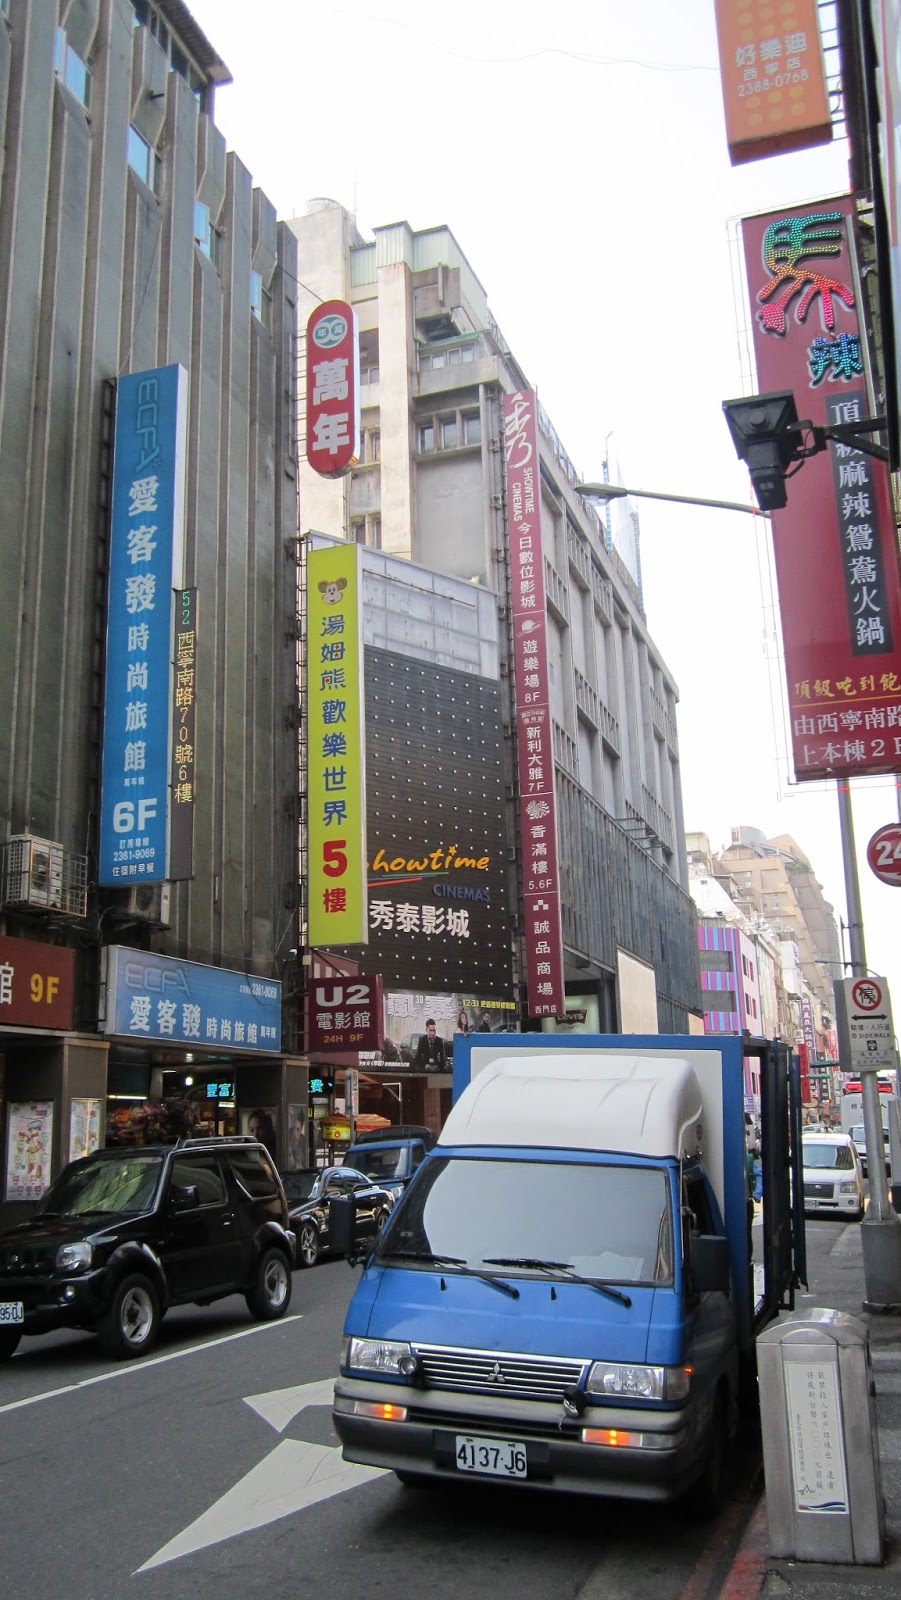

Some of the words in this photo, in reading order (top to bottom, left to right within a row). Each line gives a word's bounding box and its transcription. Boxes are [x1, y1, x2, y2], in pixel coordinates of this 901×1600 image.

[735, 32, 807, 68] 好樂迪
[738, 69, 809, 97] 2388-0768
[313, 358, 349, 455] 萬年
[512, 482, 523, 521] CINEMAS
[523, 467, 535, 513] SHOWTIME
[517, 522, 537, 608] 今日數位影城
[523, 640, 540, 688] 遊樂場
[525, 692, 540, 703] 8F
[794, 672, 901, 699] 頂級吃到飽
[320, 614, 347, 827] 湯姆熊歡樂世界
[526, 726, 544, 780] 新利大雅
[528, 782, 544, 792] 7F
[113, 798, 157, 833] 6F
[113, 848, 155, 861] 2361-9069
[366, 846, 490, 873] howtime
[530, 825, 548, 875] 香滿樓
[112, 862, 154, 877] 住宿附早餐
[432, 883, 491, 902] CINEMAS
[528, 879, 552, 890] 5.6F
[369, 899, 471, 938] 秀泰影城
[534, 921, 553, 996] 誠品商場
[30, 973, 59, 1004] 9F
[316, 984, 370, 1007] U2
[316, 1011, 370, 1031] 電影館
[535, 1004, 557, 1014] 西門店
[323, 1034, 343, 1044] 24H
[350, 1033, 364, 1042] 9F
[457, 1444, 526, 1472] 4137-J6
